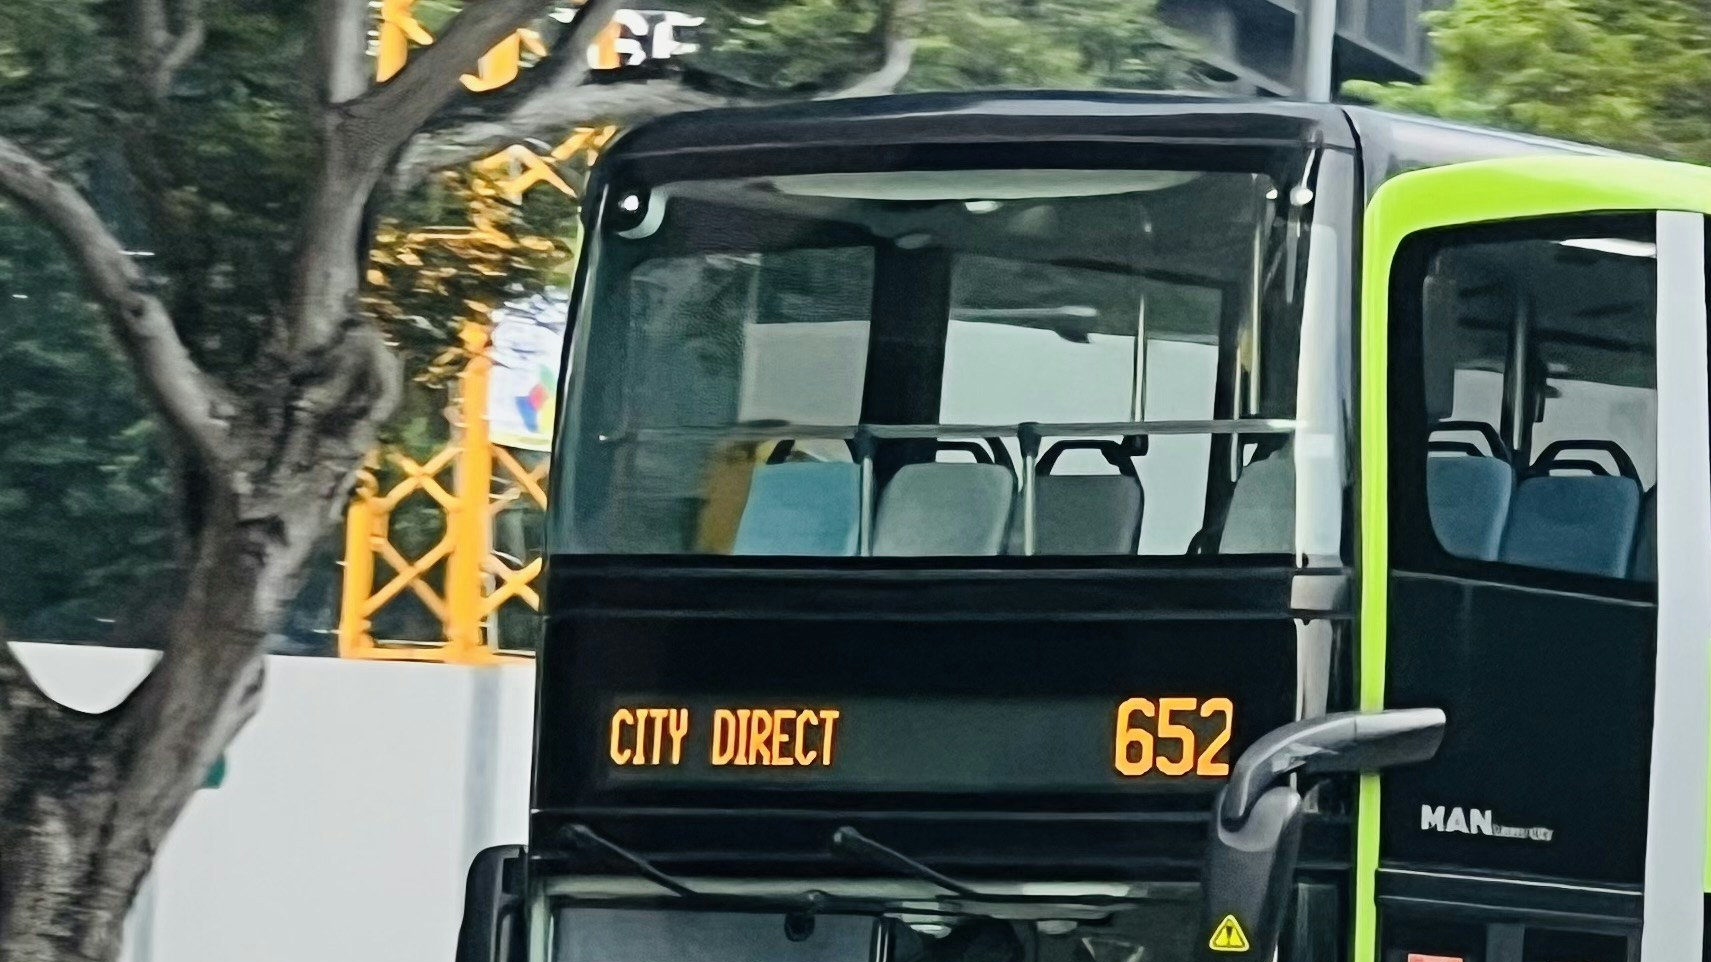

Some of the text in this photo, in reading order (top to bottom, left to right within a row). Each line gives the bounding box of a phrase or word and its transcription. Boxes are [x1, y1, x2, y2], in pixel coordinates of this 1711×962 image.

[610, 708, 840, 766] CITY DIRECT
[1113, 697, 1234, 776] 652
[1421, 804, 1493, 836] MAN
